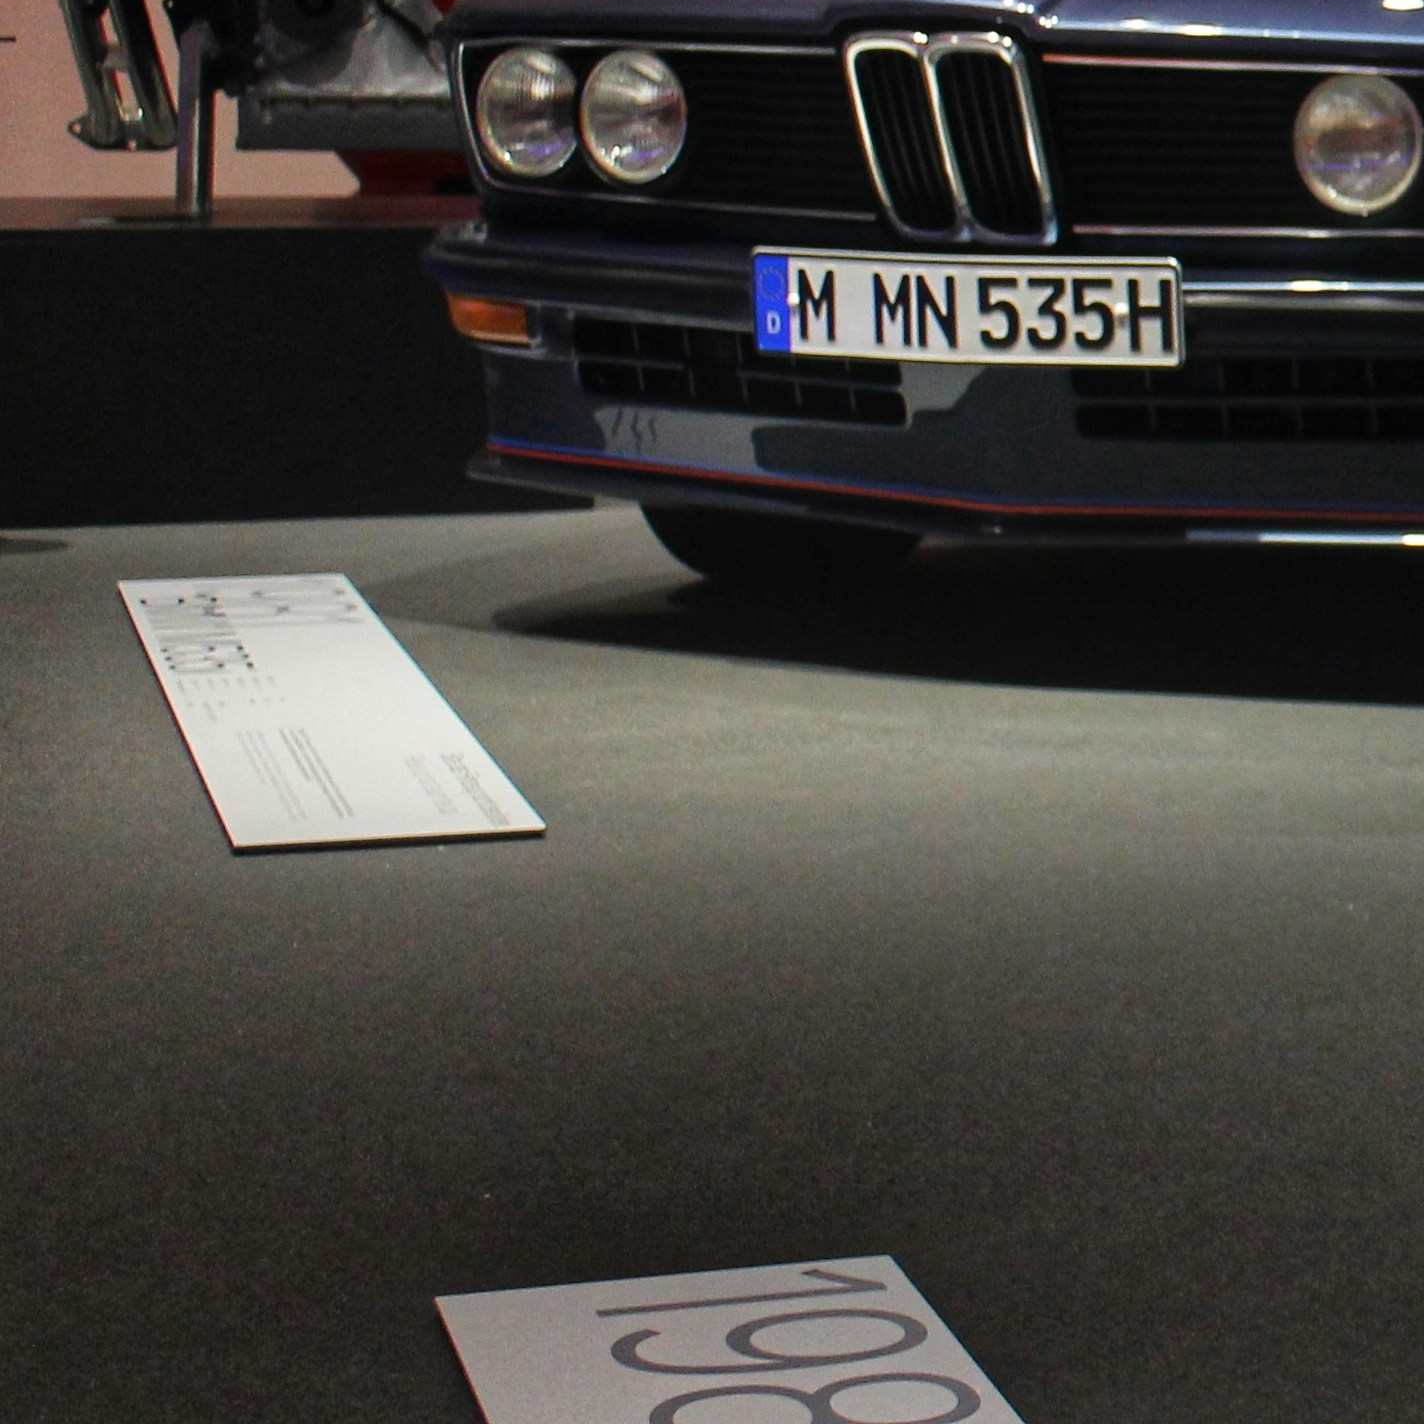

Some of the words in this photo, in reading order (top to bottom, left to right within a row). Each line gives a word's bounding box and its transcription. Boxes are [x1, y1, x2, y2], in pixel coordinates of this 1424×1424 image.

[766, 311, 781, 335] D
[797, 268, 837, 342] M
[873, 272, 959, 349] MN
[977, 277, 1175, 353] 535H
